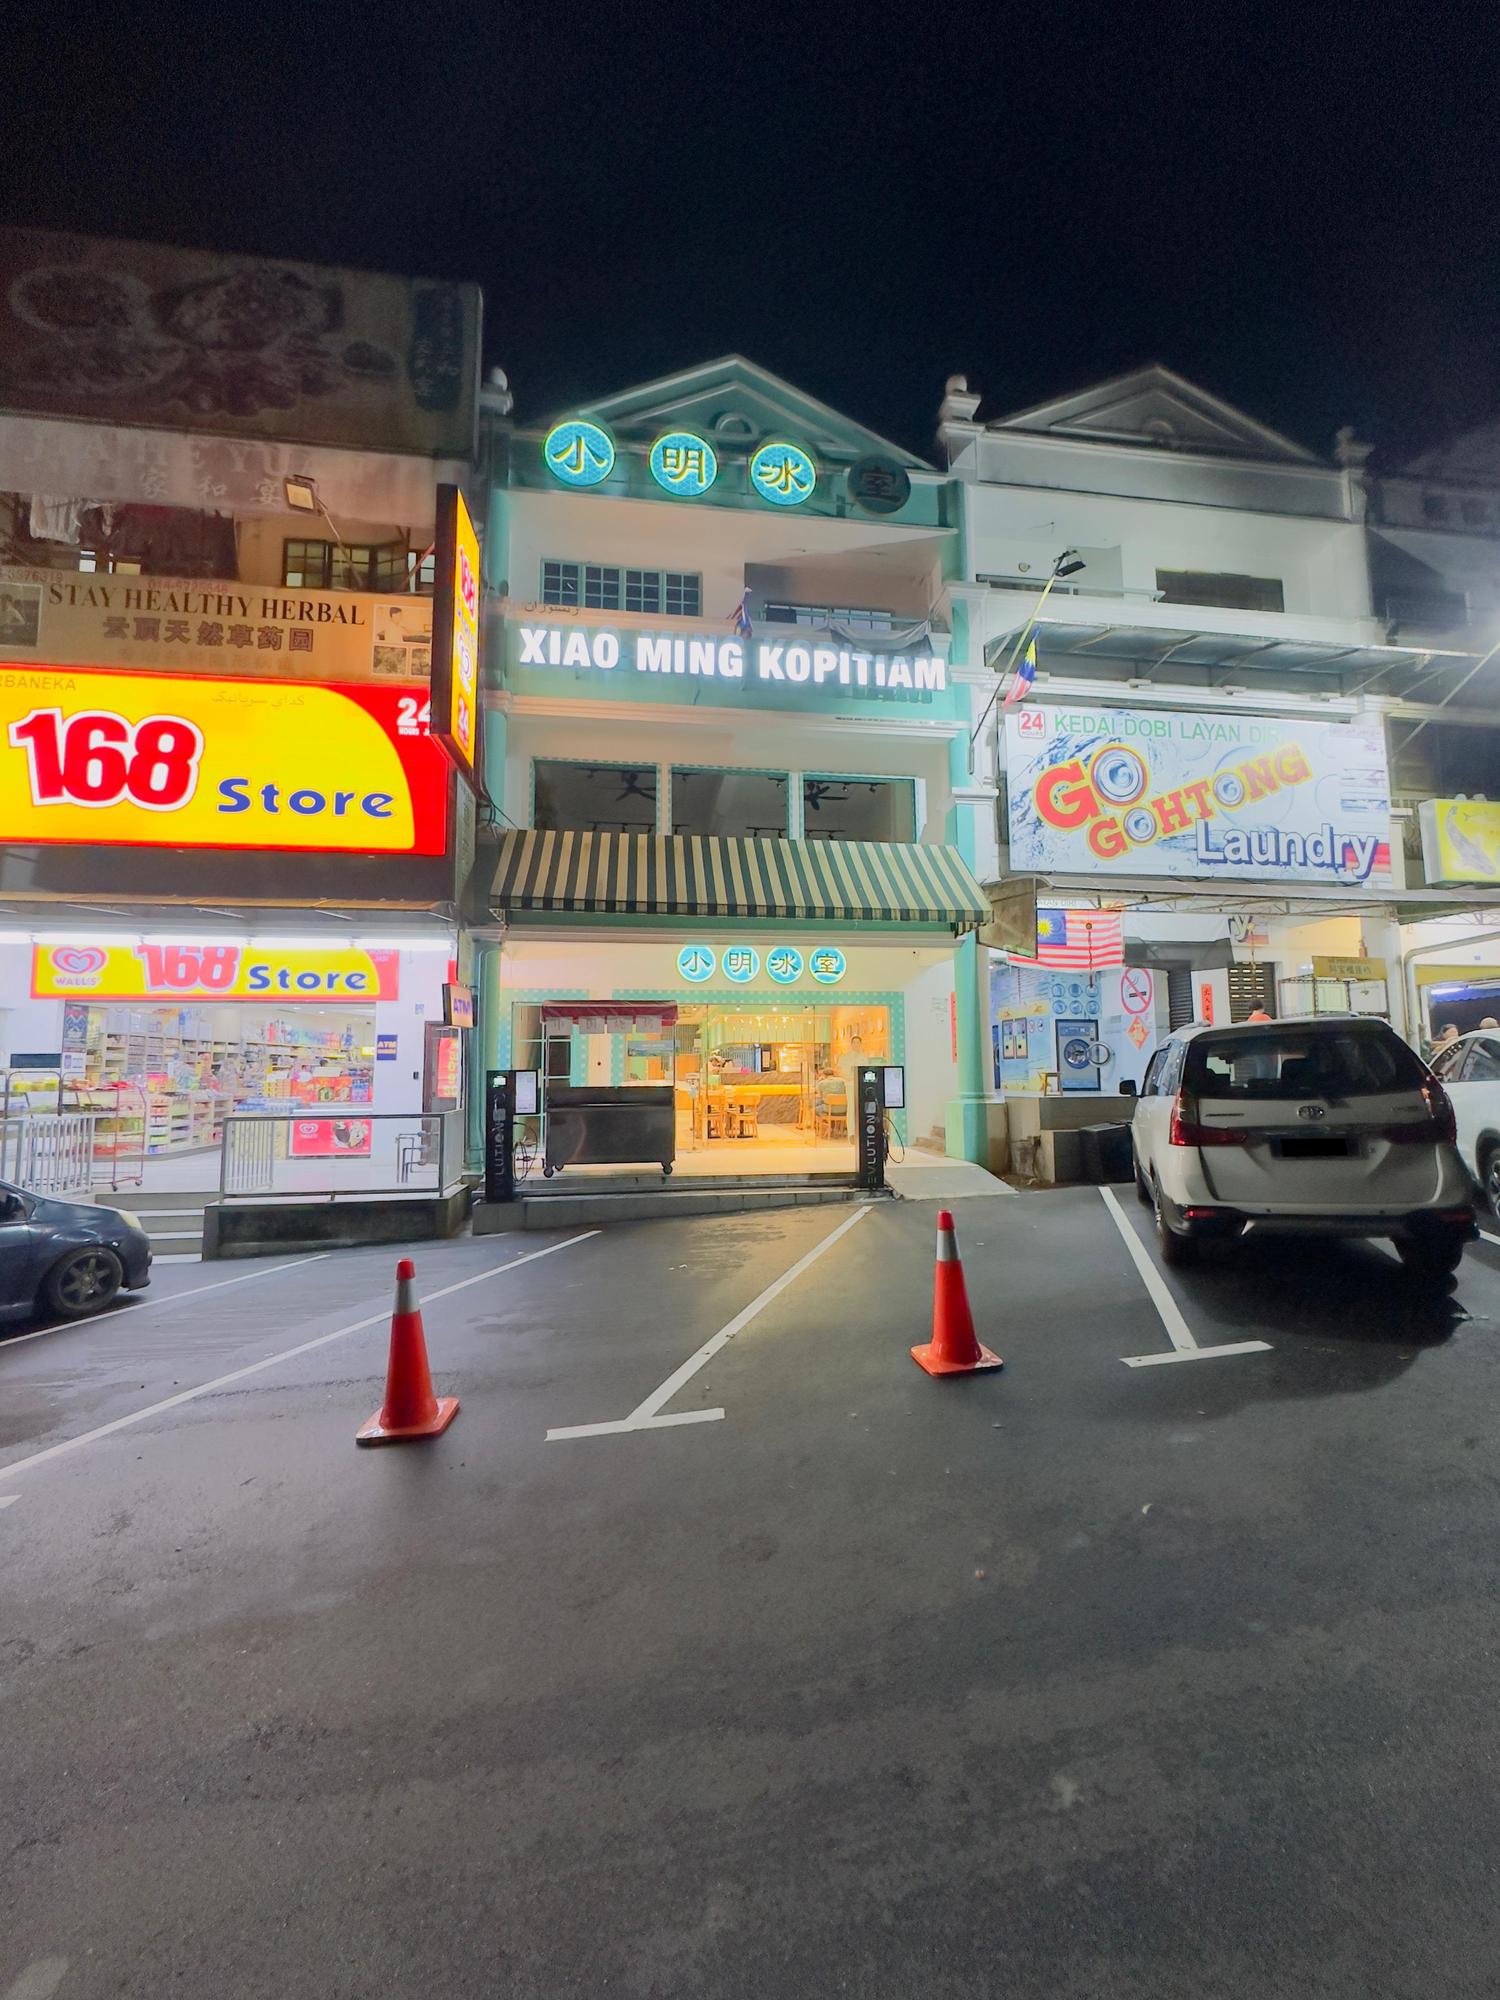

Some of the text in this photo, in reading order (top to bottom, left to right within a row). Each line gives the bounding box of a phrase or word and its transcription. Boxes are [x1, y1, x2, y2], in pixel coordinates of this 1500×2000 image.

[49, 583, 366, 626] STAY HEALTHY HERBAL
[102, 615, 315, 653] 云顶天然草药园
[519, 627, 947, 691] XIAO MING KOPITIAM
[1021, 712, 1043, 731] 24
[1054, 714, 1116, 735] KEDAI
[1124, 717, 1172, 738] DOBI
[1180, 719, 1241, 743] LAYAN
[9, 708, 395, 818] 168 Store
[1035, 743, 1149, 830] GO
[1087, 745, 1311, 859] GOHTONG
[1195, 817, 1380, 880] Laundry
[135, 945, 239, 991] 168
[249, 965, 367, 990] Store
[682, 951, 841, 975] 小明冰室
[453, 997, 472, 1016] ATM
[378, 1041, 397, 1049] ATM
